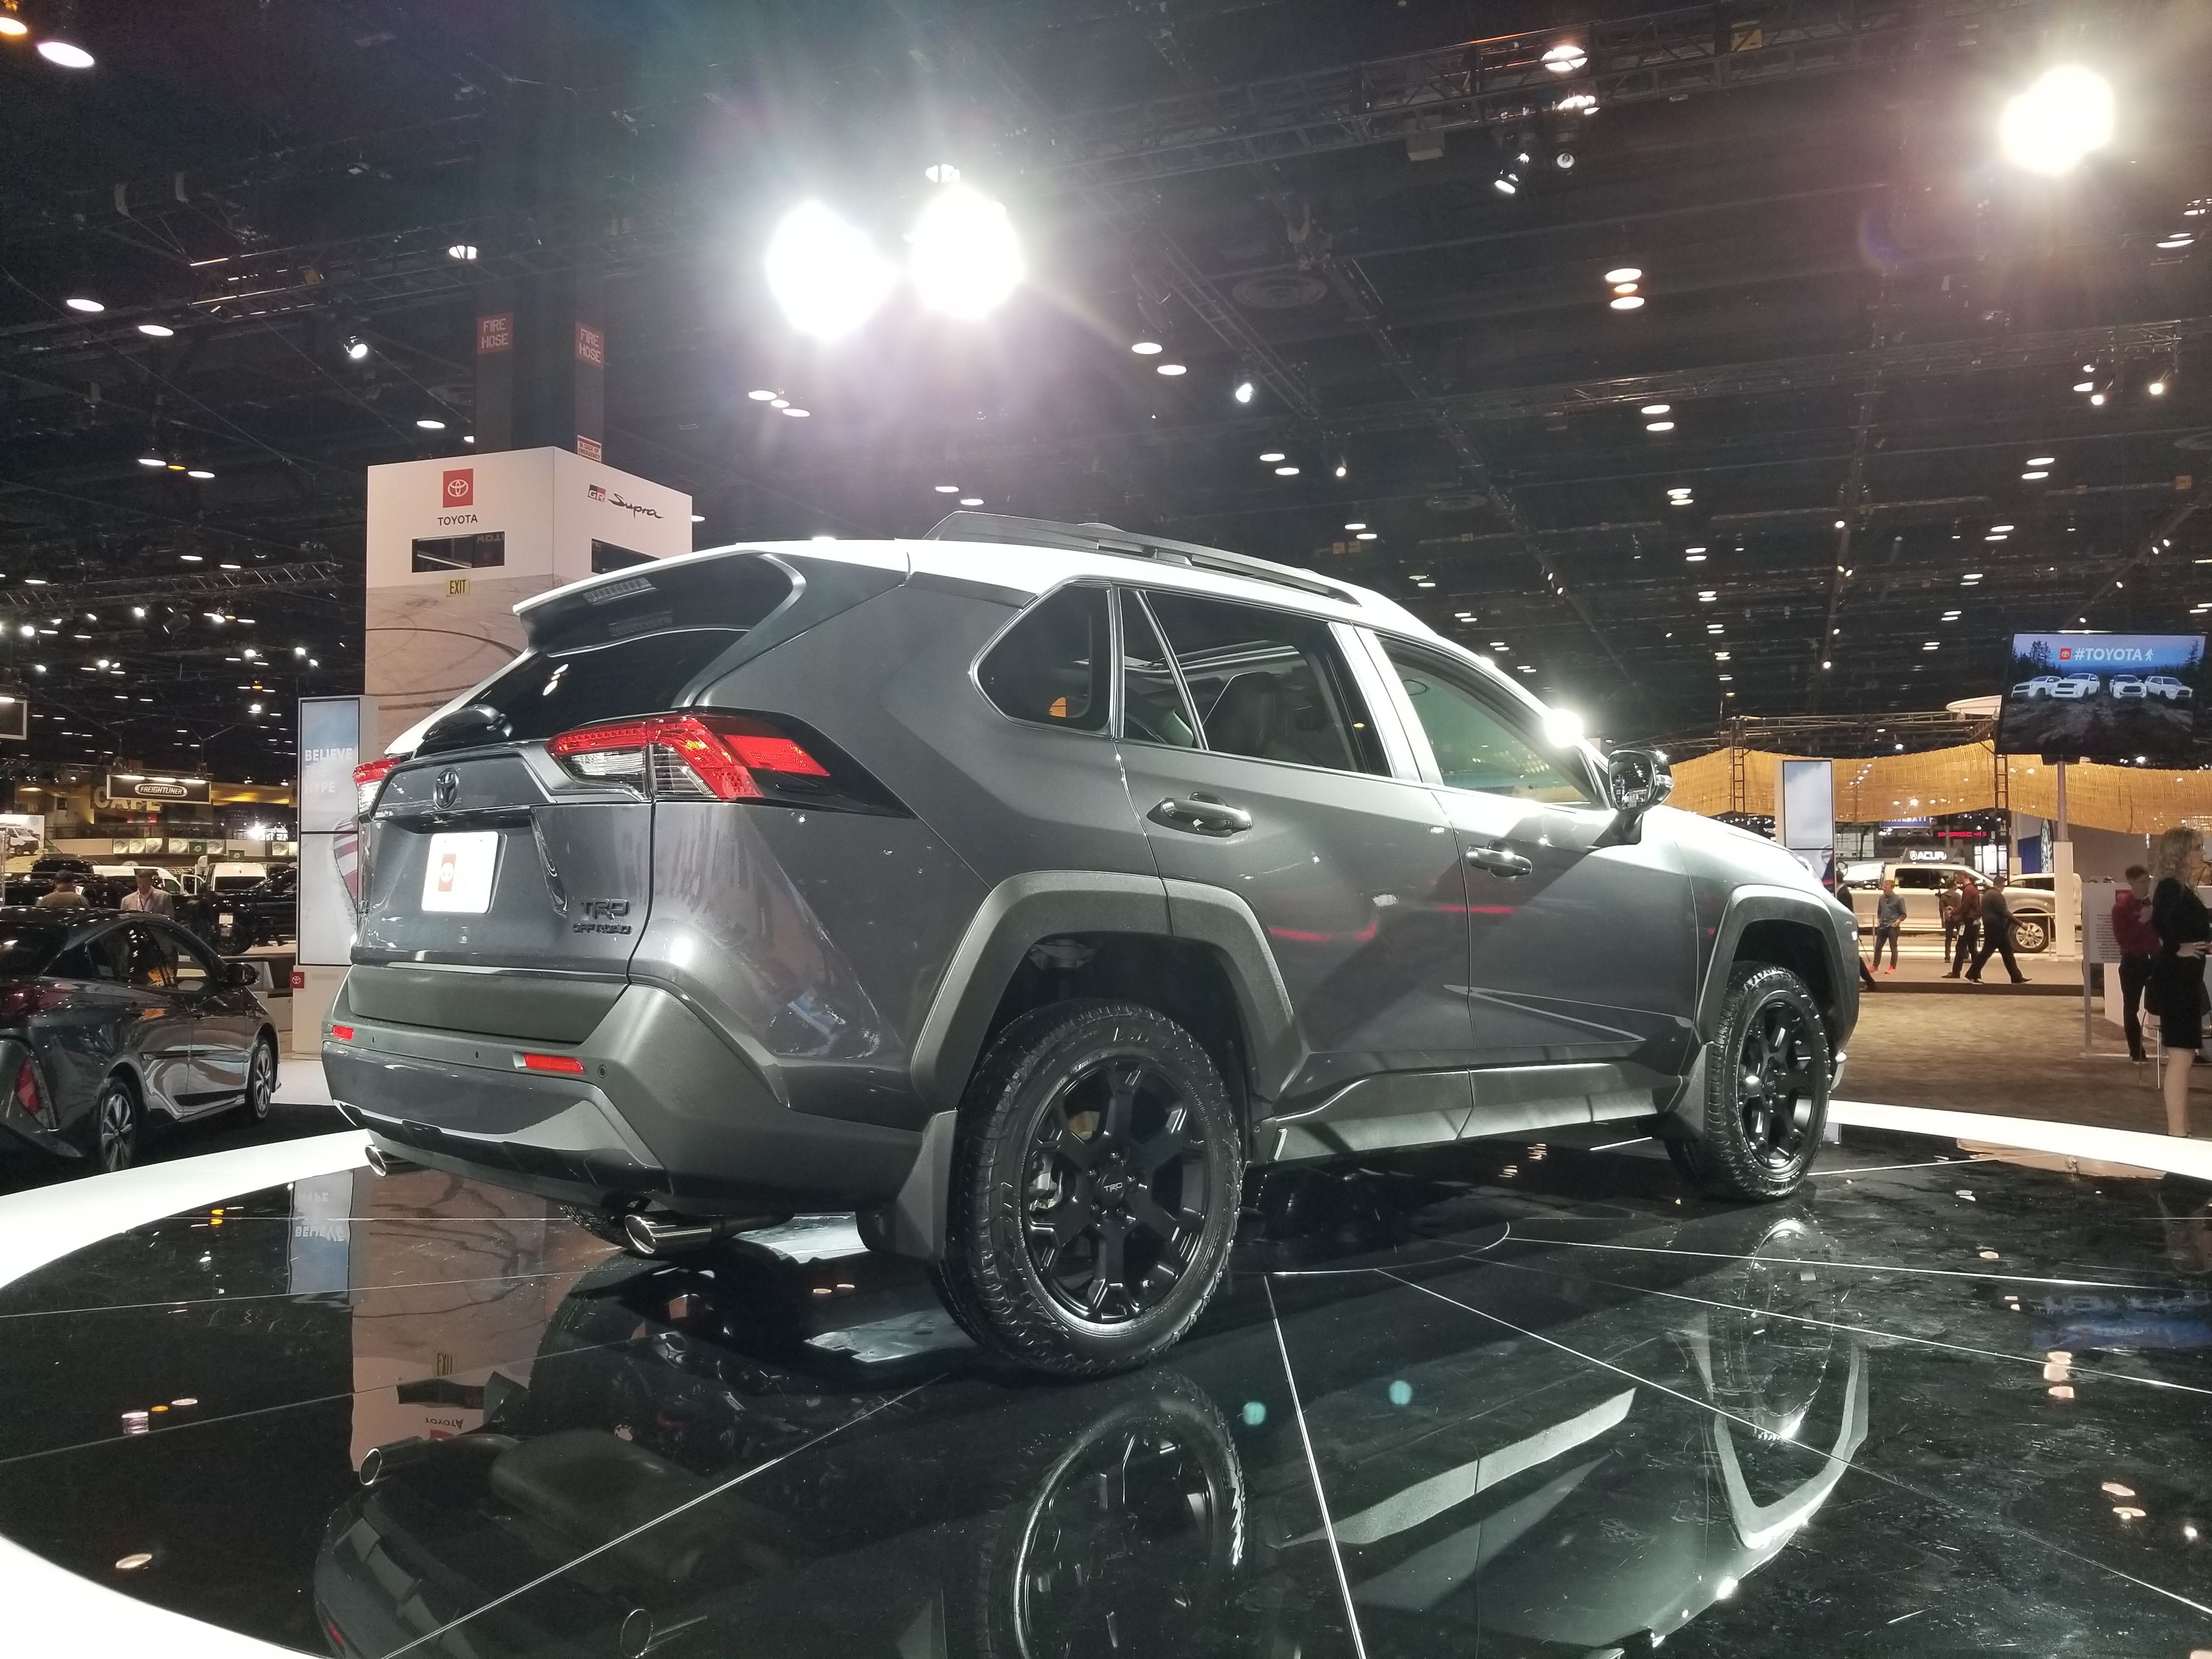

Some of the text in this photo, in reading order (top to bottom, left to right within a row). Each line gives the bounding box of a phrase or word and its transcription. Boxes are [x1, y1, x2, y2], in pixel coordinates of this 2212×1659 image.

[483, 318, 506, 333] FIRE
[481, 333, 509, 348] HOSE
[580, 328, 600, 347] FIRE
[579, 342, 601, 363] HOSE
[588, 489, 664, 519] GR Supra
[437, 514, 478, 526] TOYOTA
[449, 579, 466, 594] EXIT
[304, 748, 353, 761] BELIEVE
[140, 786, 183, 795] FREIGHTLINER
[304, 781, 335, 793] HYPE
[581, 898, 629, 919] TRD
[1103, 1182, 1122, 1193] TRD
